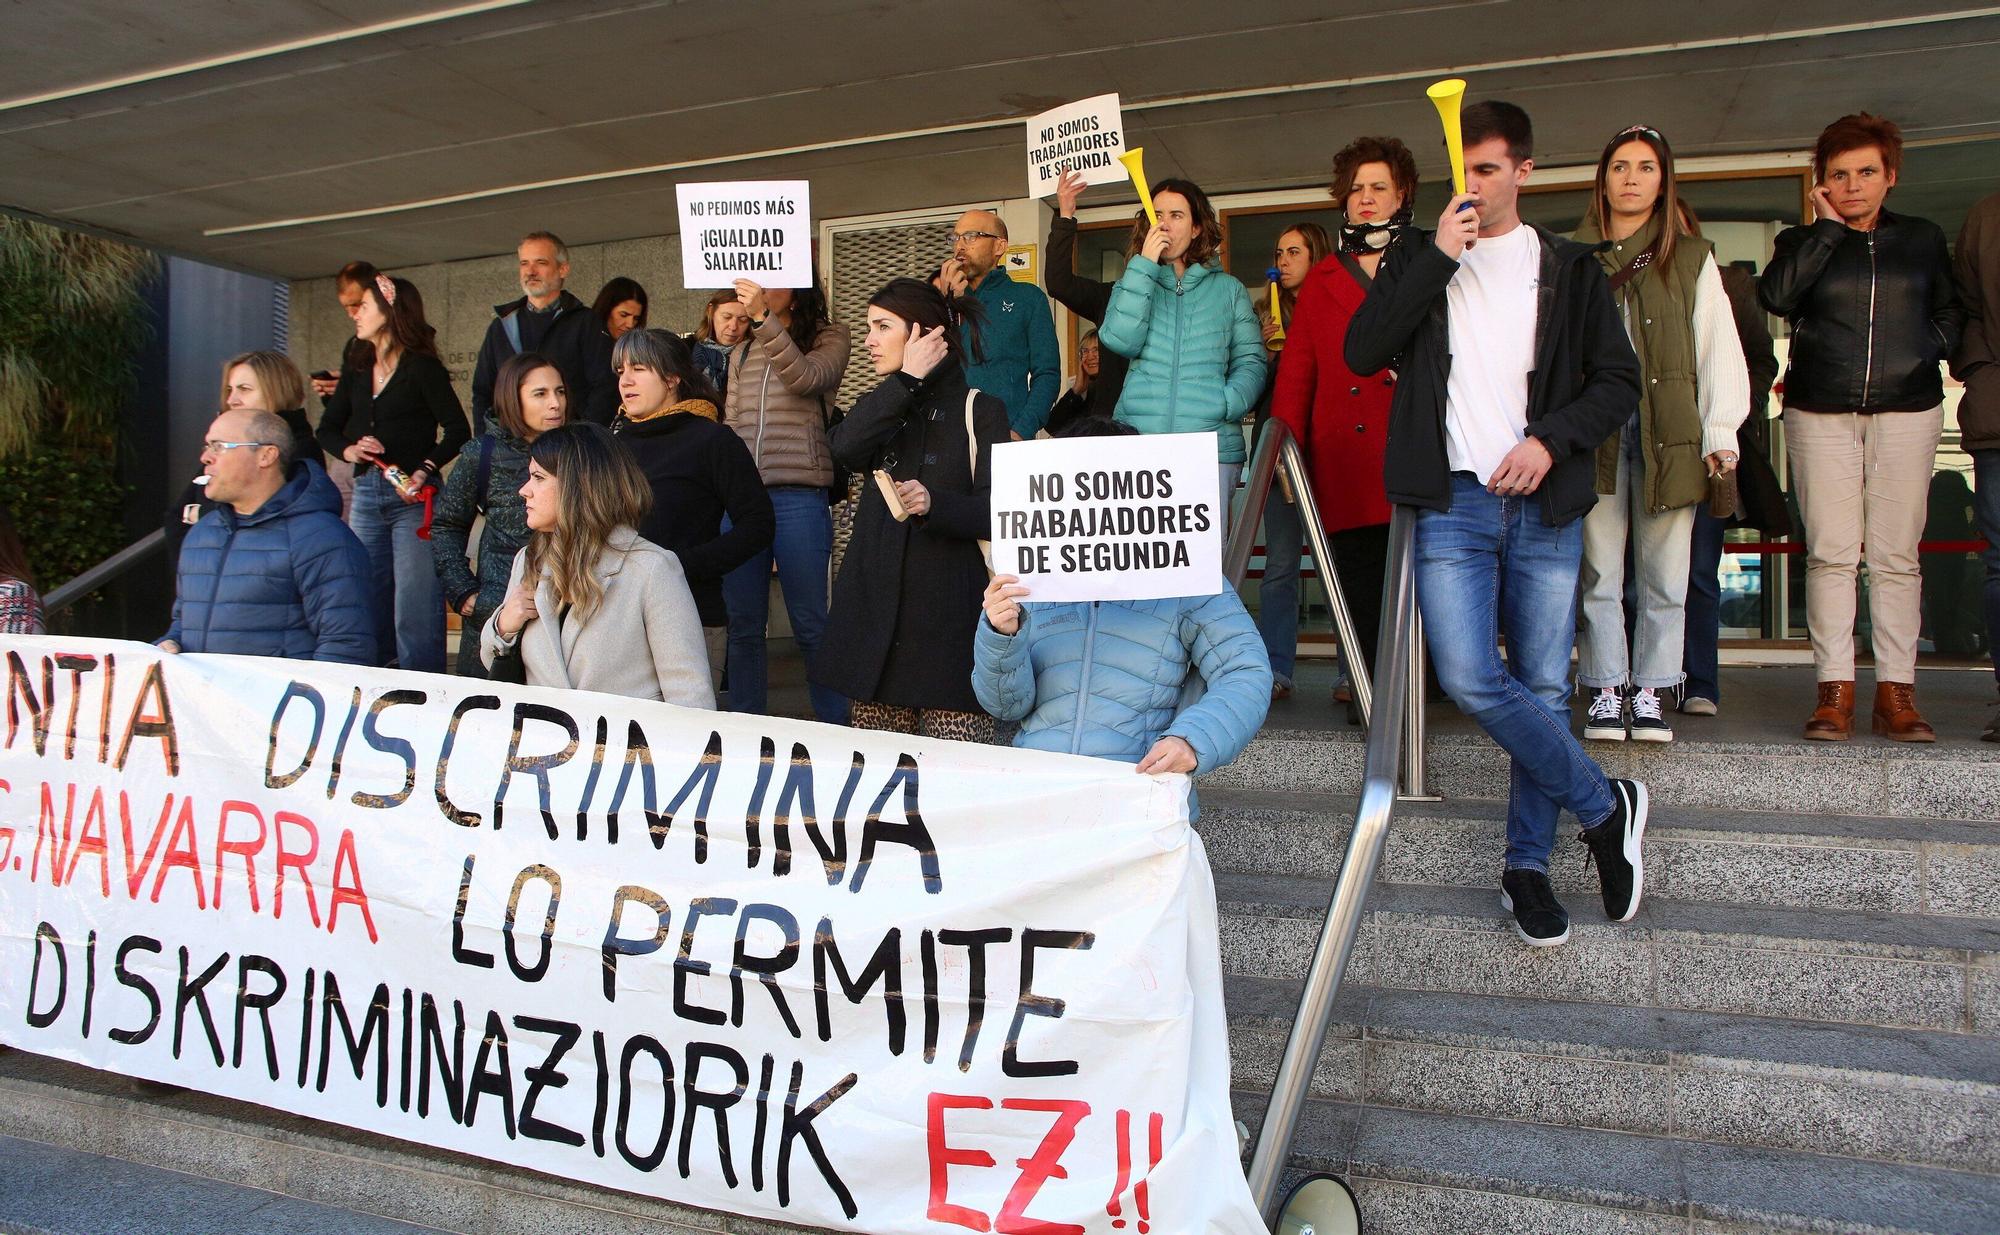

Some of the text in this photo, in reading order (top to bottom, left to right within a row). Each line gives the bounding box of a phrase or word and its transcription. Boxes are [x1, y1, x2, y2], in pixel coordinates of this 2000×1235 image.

[1040, 115, 1099, 144] NO SOMOS
[1029, 131, 1119, 165] TRABAJADORES
[1039, 151, 1111, 181] DE SEGUNDA
[690, 196, 795, 216] NO PEDIMOS MÁS
[700, 229, 784, 251] ¡IGUALDAD
[704, 252, 783, 271] SALARIAL!
[1028, 469, 1173, 502] NO SOMOS
[997, 503, 1211, 540] TRABAJADORES
[1017, 540, 1191, 574] DE SEGUNDA
[4, 650, 942, 894] NTIA DISCRIMINA
[452, 854, 562, 983] LO
[602, 885, 1096, 1078] PERMITE
[26, 921, 858, 1220] DISKRIMINAZIORIK
